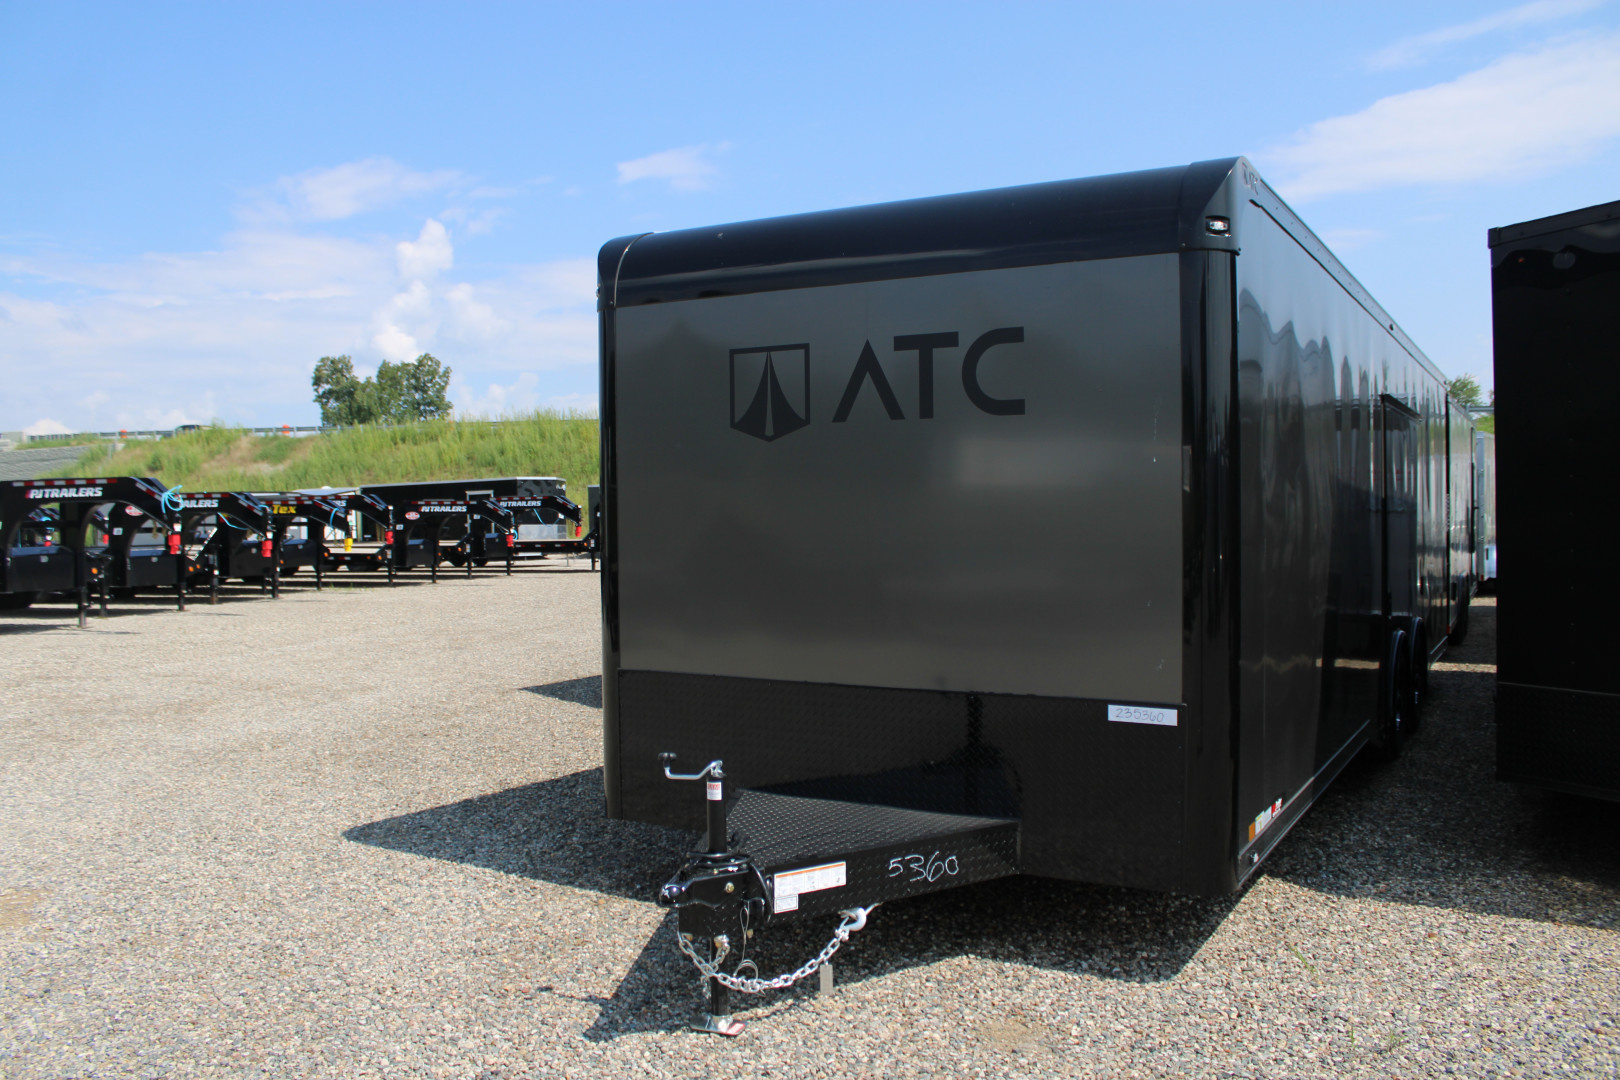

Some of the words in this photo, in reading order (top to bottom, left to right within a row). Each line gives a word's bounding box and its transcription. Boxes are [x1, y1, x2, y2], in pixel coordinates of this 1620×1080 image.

[832, 326, 1025, 423] ATC
[29, 488, 43, 499] PJ
[43, 487, 103, 499] TRAILERS
[272, 504, 297, 514] Tex
[1115, 707, 1165, 723] 235360
[888, 850, 960, 883] 5360
